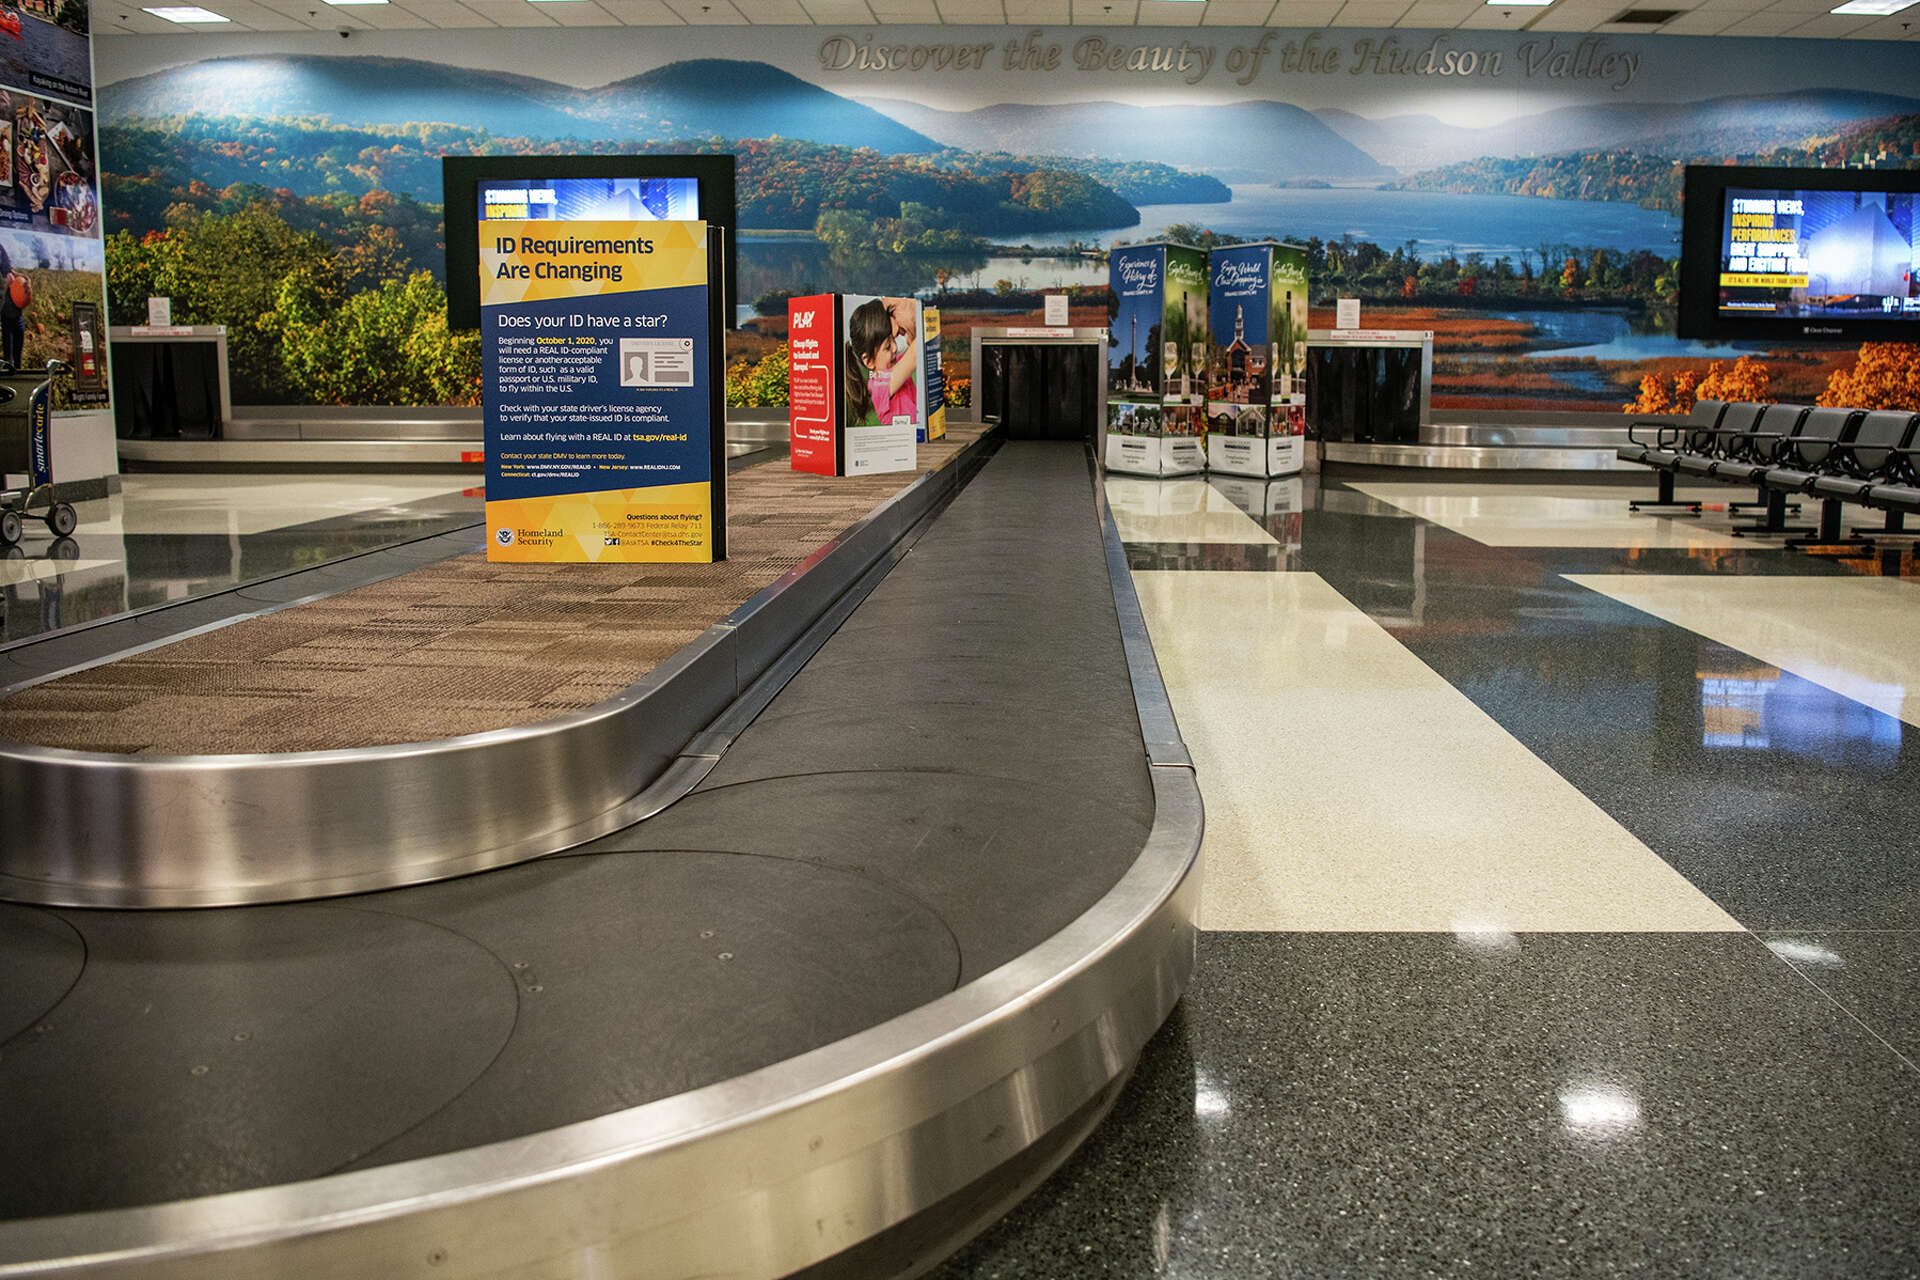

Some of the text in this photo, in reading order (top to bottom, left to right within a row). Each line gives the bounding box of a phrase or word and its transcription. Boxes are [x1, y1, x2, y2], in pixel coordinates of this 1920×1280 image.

[817, 31, 1641, 91] Discover the Beauty of the Hudson Valley
[496, 237, 654, 258] ID Requirements
[496, 262, 622, 282] Are Changing
[498, 314, 668, 329] Does your ID have a star?
[793, 311, 816, 329] PLAY
[498, 337, 535, 346] Beginning
[536, 337, 566, 345] October
[576, 337, 597, 346] 2020,
[598, 338, 614, 347] you
[560, 347, 608, 356] ID-compliant
[498, 356, 524, 364] license
[528, 366, 538, 374] ID,
[499, 376, 531, 384] passport
[557, 376, 586, 385] military
[508, 385, 519, 393] fly
[500, 404, 521, 412] Check
[541, 405, 558, 413] your
[580, 404, 608, 412] driver's
[609, 405, 634, 413] license
[635, 406, 662, 414] agency
[509, 414, 532, 423] verify
[550, 415, 568, 423] your
[569, 414, 613, 422] state-issued
[631, 415, 670, 423] compliant.
[34, 403, 46, 473] smartecarte
[500, 433, 521, 441] Learn
[522, 433, 543, 441] about
[545, 433, 567, 442] flying
[568, 433, 585, 441] with
[592, 433, 613, 441] REAL
[614, 433, 623, 441] ID
[632, 433, 687, 442] tsa.gov/real-id
[501, 452, 523, 460] Contact
[680, 514, 702, 522] flying?
[671, 522, 689, 530] Relay
[517, 528, 563, 537] Homeland
[517, 537, 553, 548] Security
[650, 539, 703, 547] #Check4TheStar
